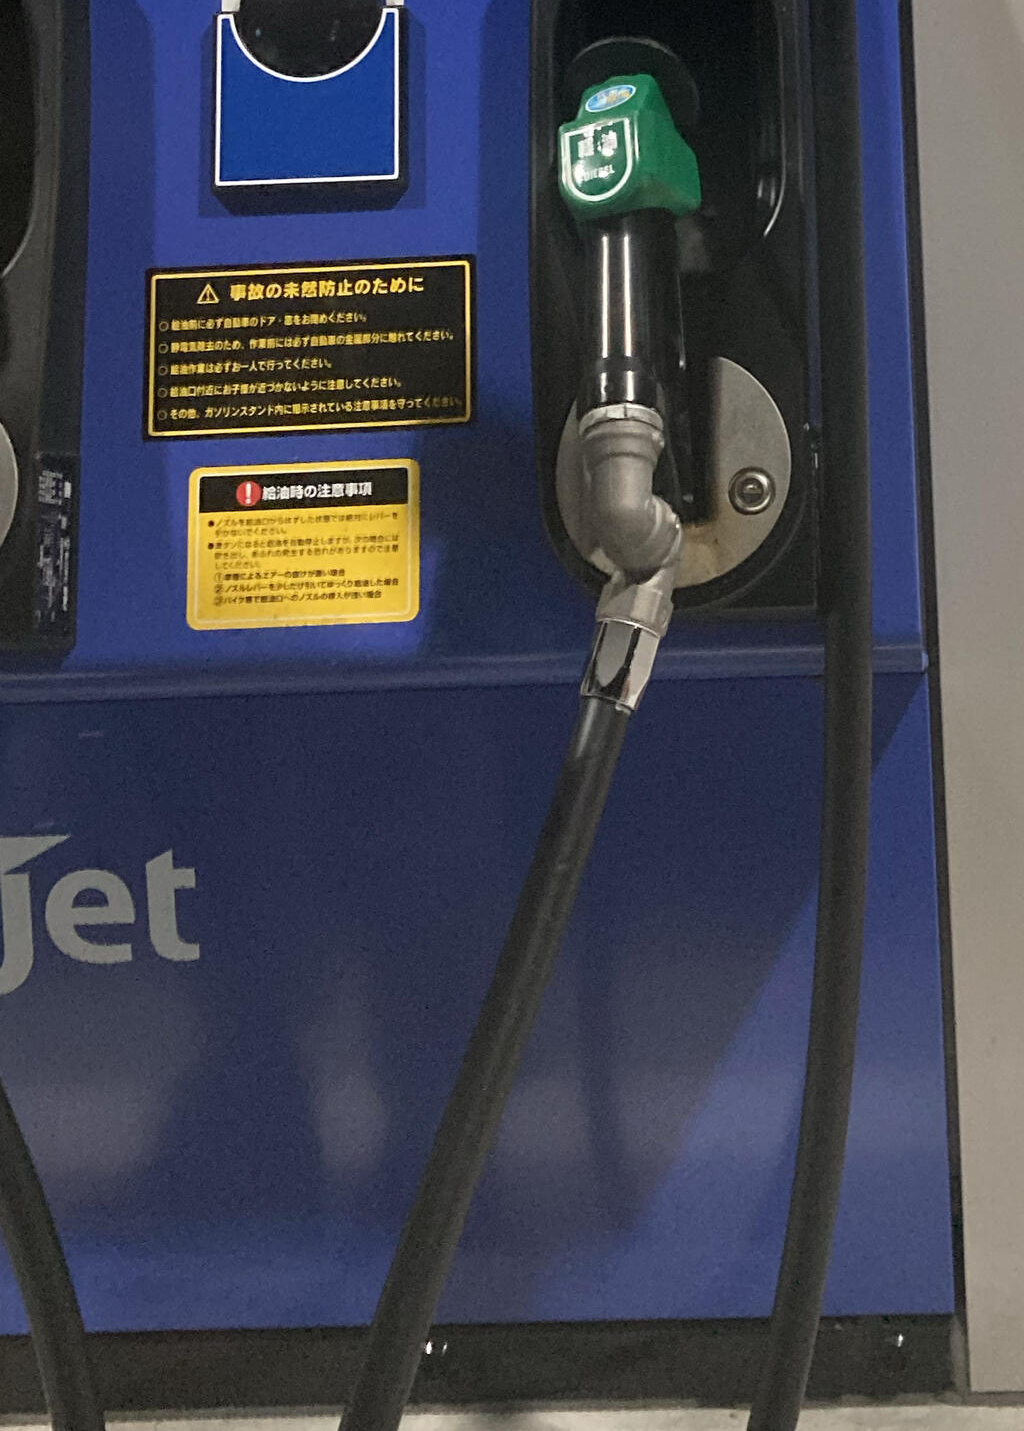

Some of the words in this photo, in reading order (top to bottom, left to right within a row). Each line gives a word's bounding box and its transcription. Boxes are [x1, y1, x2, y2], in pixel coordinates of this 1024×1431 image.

[230, 276, 424, 302] 事故の未然防止のために
[261, 481, 373, 501] 給油時の注意事項
